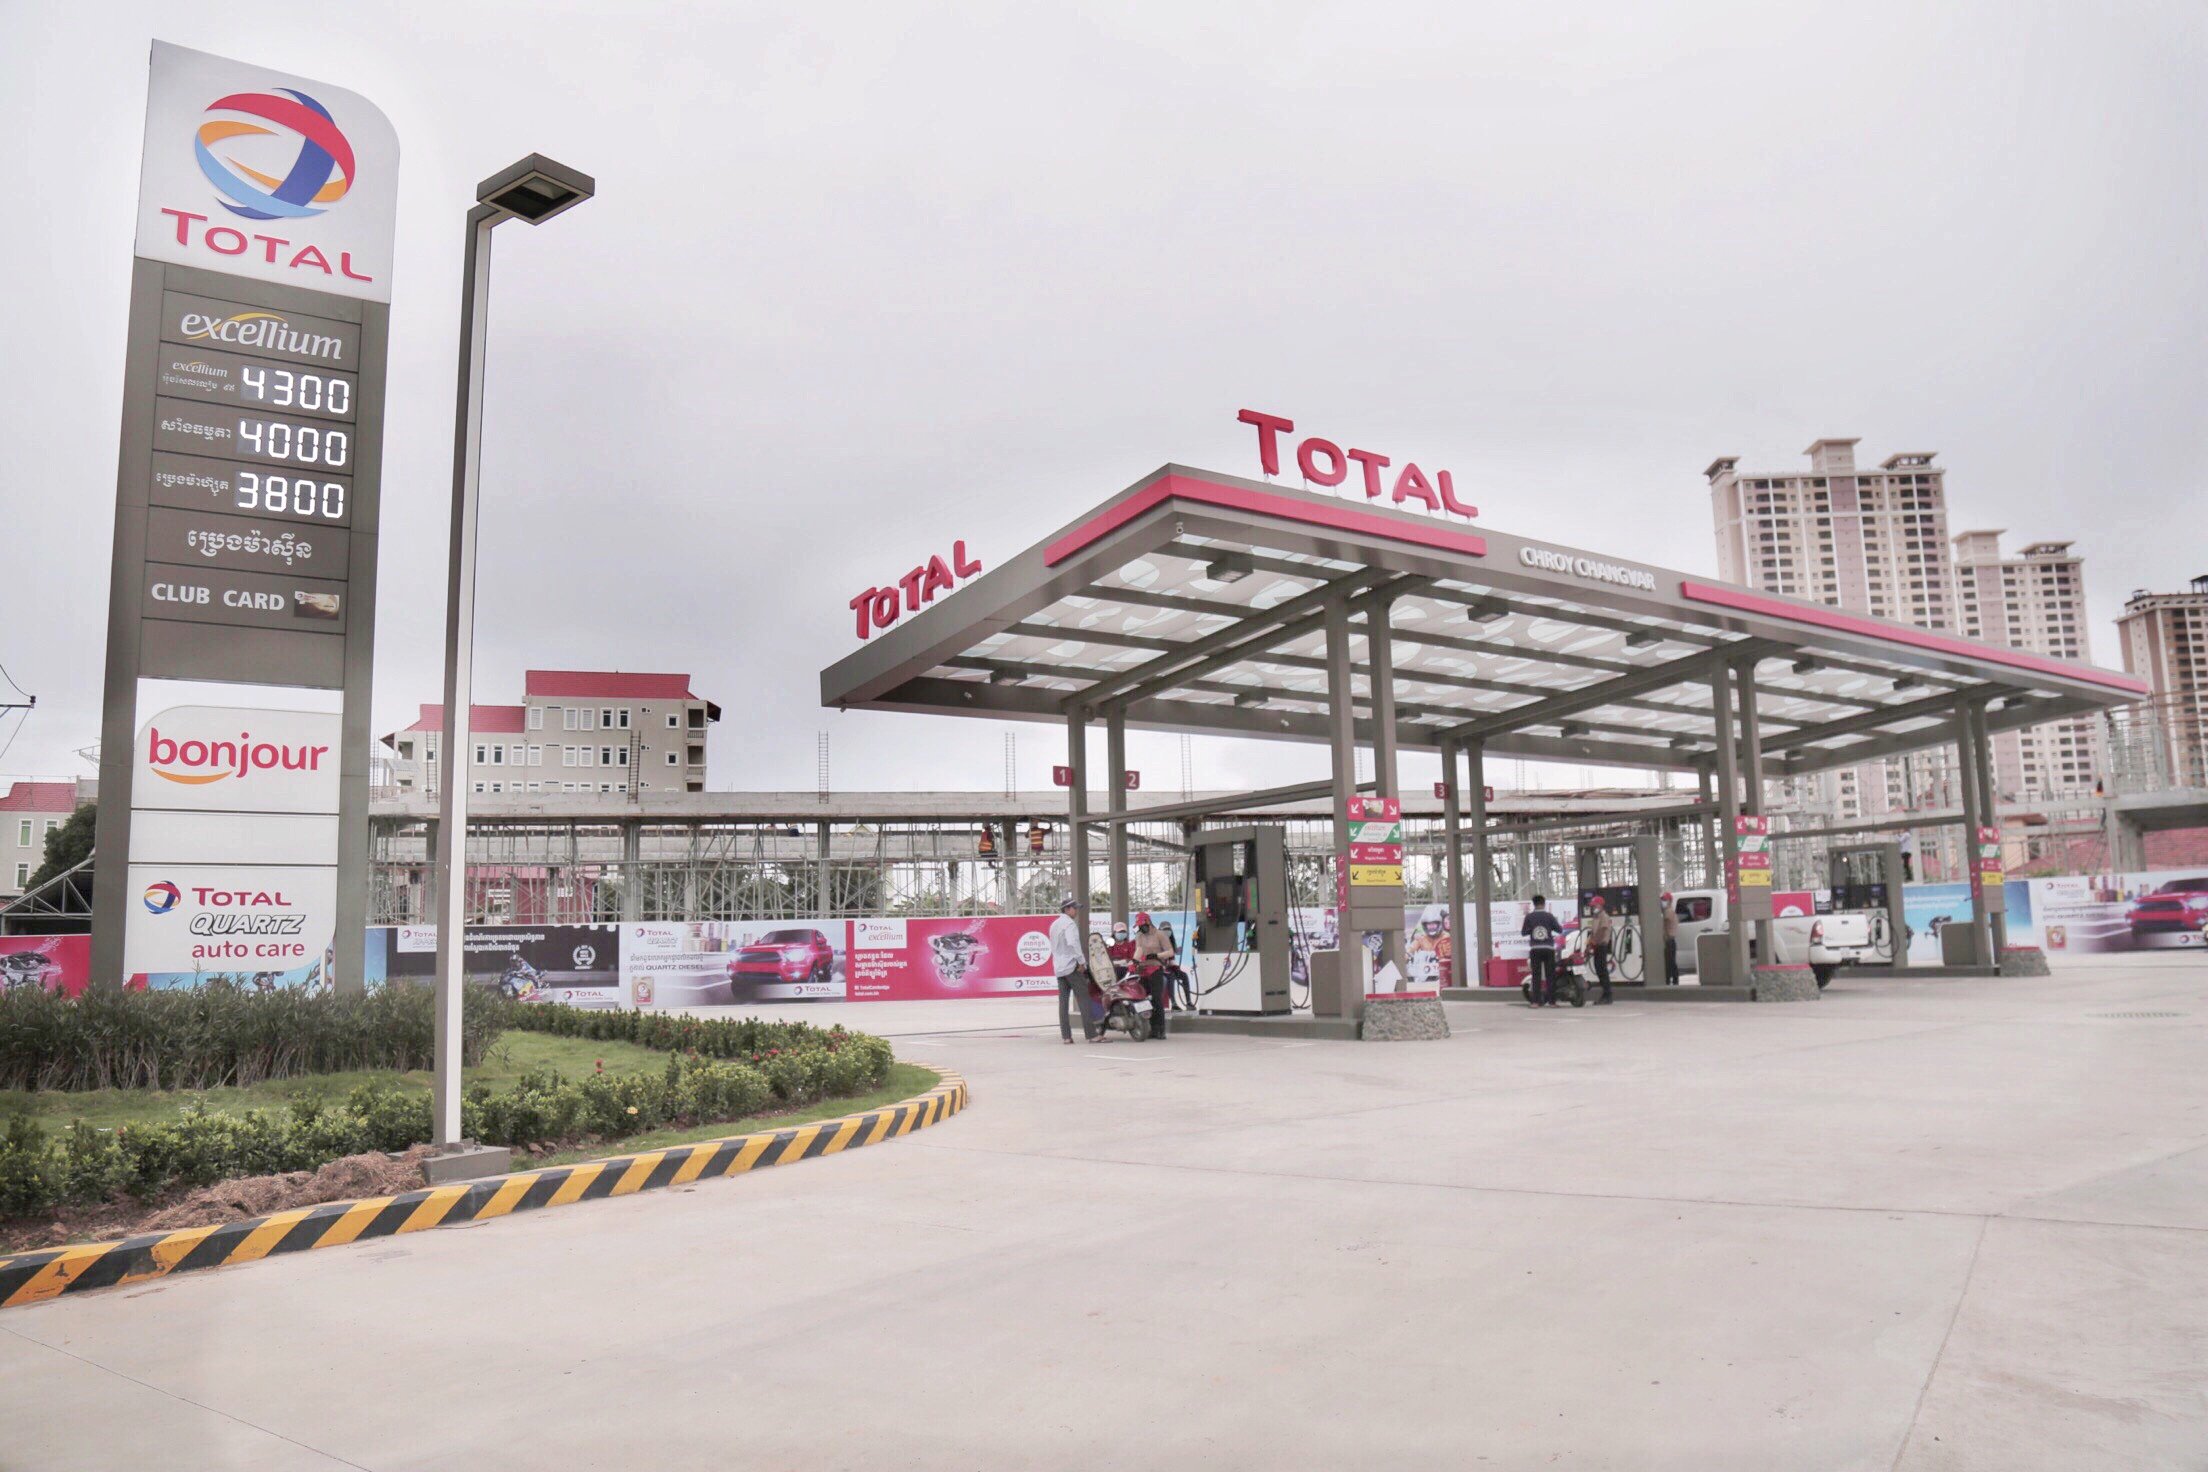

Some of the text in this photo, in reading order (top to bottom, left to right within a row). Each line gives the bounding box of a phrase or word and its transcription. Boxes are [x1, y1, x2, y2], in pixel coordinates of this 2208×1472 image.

[161, 207, 373, 283] TOTAL
[180, 312, 342, 360] excellium
[172, 361, 229, 378] excellium
[243, 367, 350, 414] 4300
[239, 420, 348, 466] 4000
[1237, 408, 1478, 518] TOTAL
[238, 472, 345, 519] 3800
[1519, 547, 1656, 592] CHROY CHANGVAR
[151, 583, 285, 611] CLUB CARD
[850, 540, 982, 639] TOTAL
[149, 727, 329, 779] bonjour
[1059, 769, 1066, 783] 1
[1128, 773, 1136, 787] 2
[1439, 785, 1445, 797] 3
[192, 887, 292, 906] TOTAL
[189, 912, 306, 936] QUARTZ
[868, 931, 904, 941] excellium
[192, 940, 305, 958] auto care
[1023, 952, 1041, 962] 93
